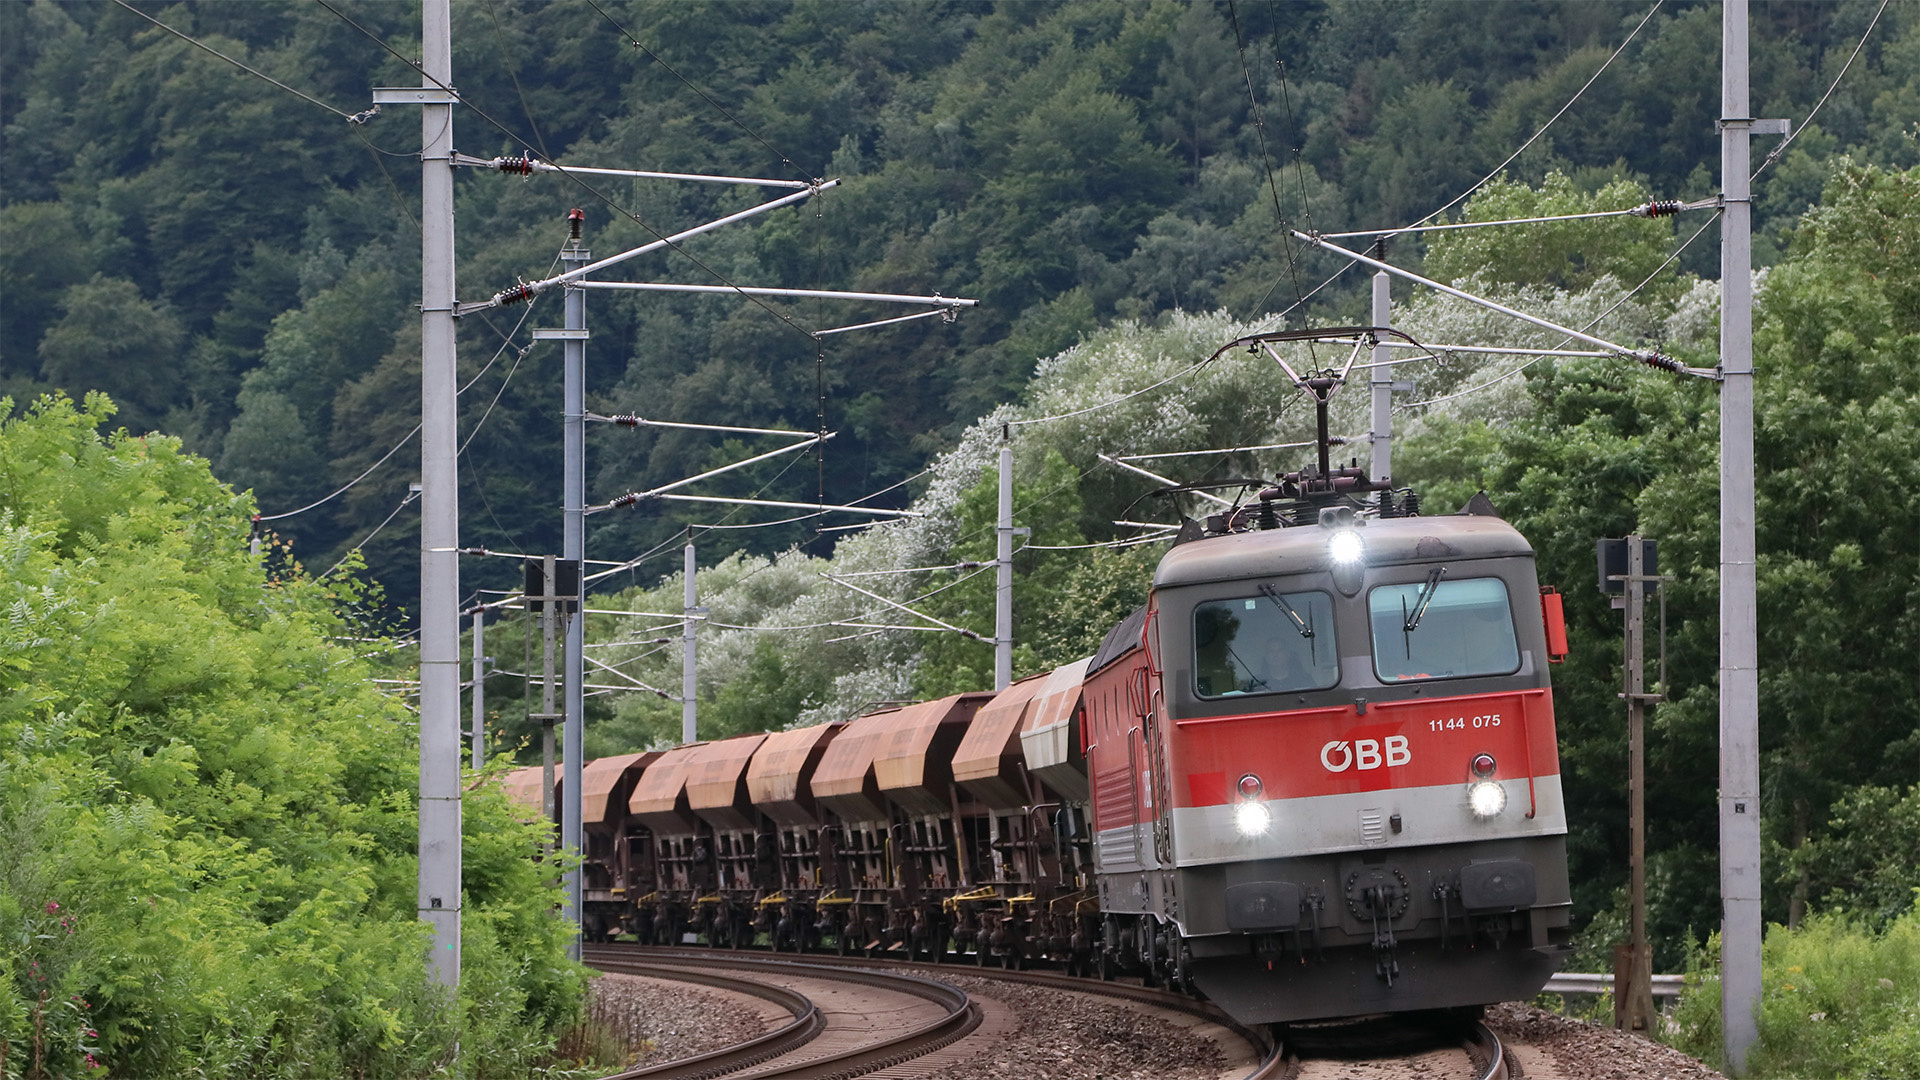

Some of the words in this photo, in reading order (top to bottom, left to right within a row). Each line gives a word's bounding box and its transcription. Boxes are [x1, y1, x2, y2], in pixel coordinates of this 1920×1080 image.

[1428, 717, 1465, 732] 1144
[1472, 714, 1501, 729] 075
[1320, 735, 1412, 773] ÖBB
